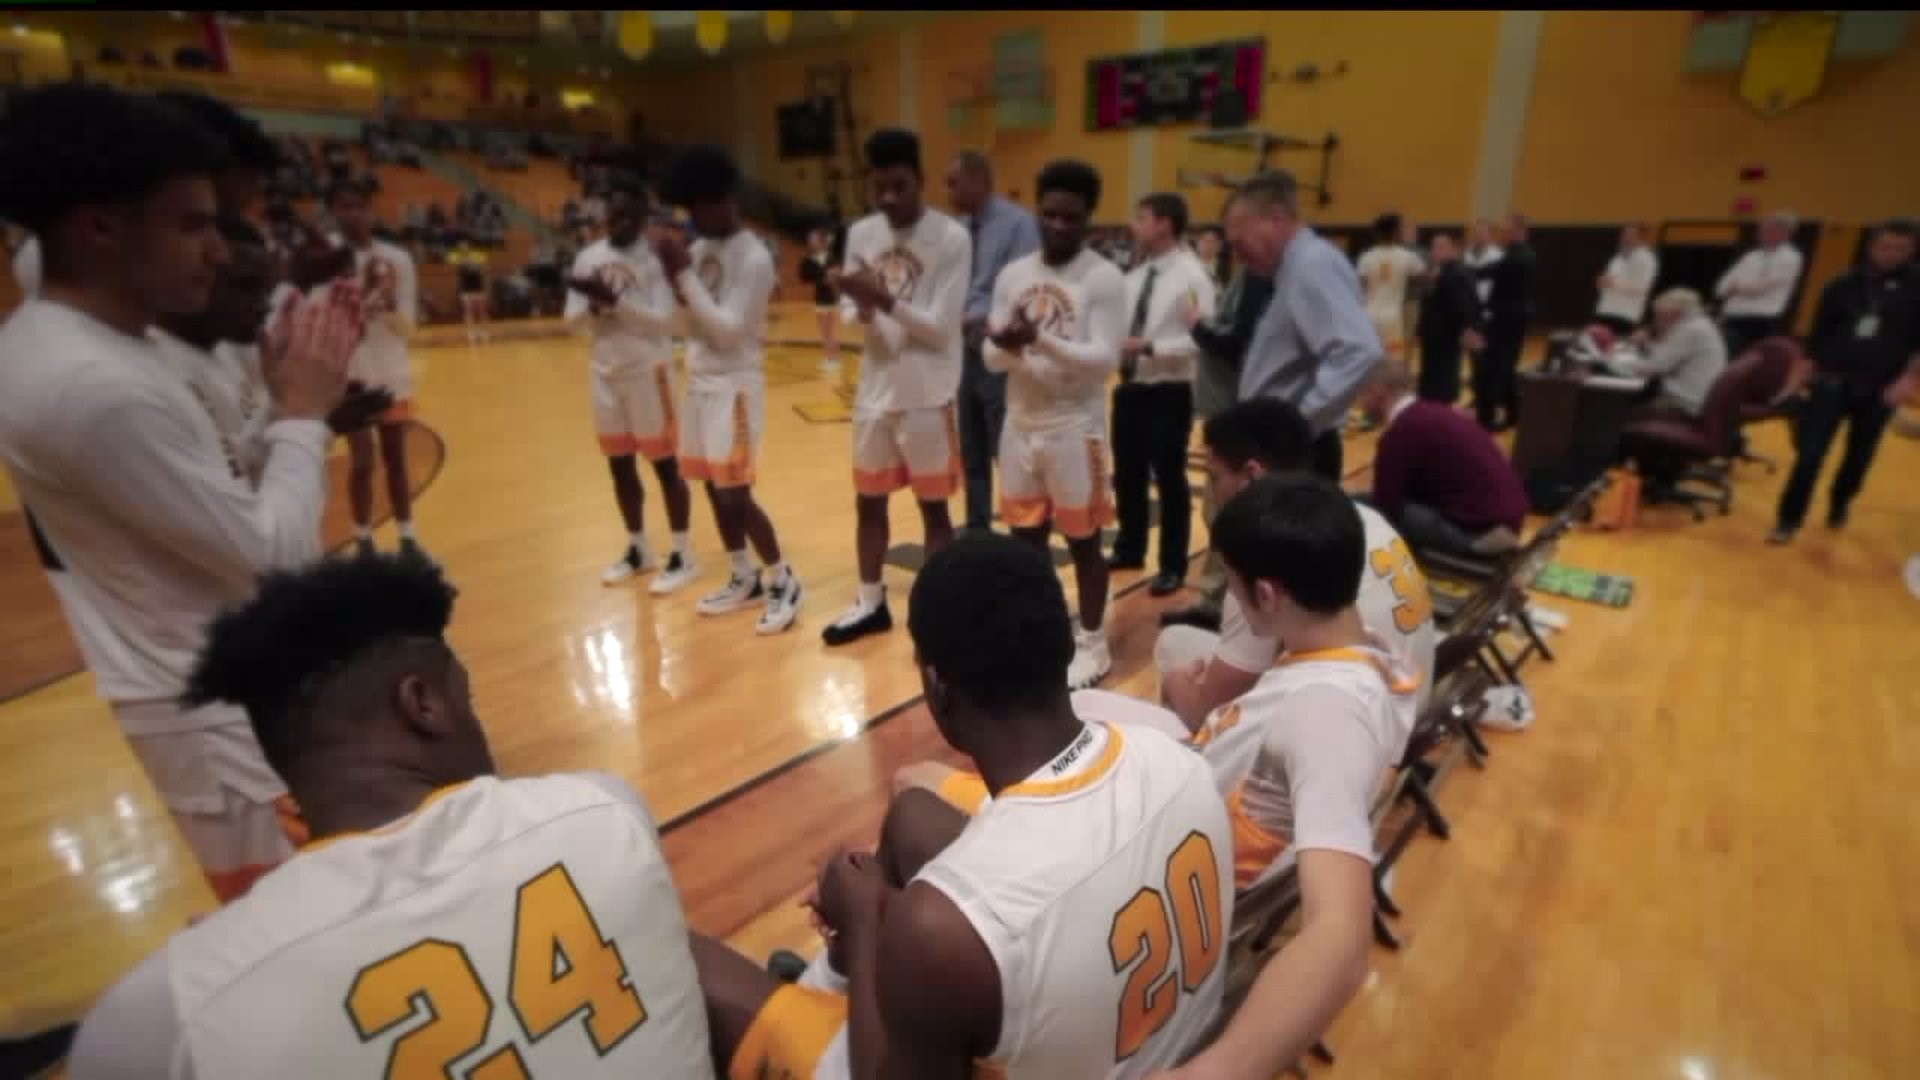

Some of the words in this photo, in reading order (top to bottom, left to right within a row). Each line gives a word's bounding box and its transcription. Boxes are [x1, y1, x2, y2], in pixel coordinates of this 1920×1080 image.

[1051, 747, 1079, 776] NIKE
[344, 861, 649, 1080] 24
[1108, 829, 1223, 1064] 20
